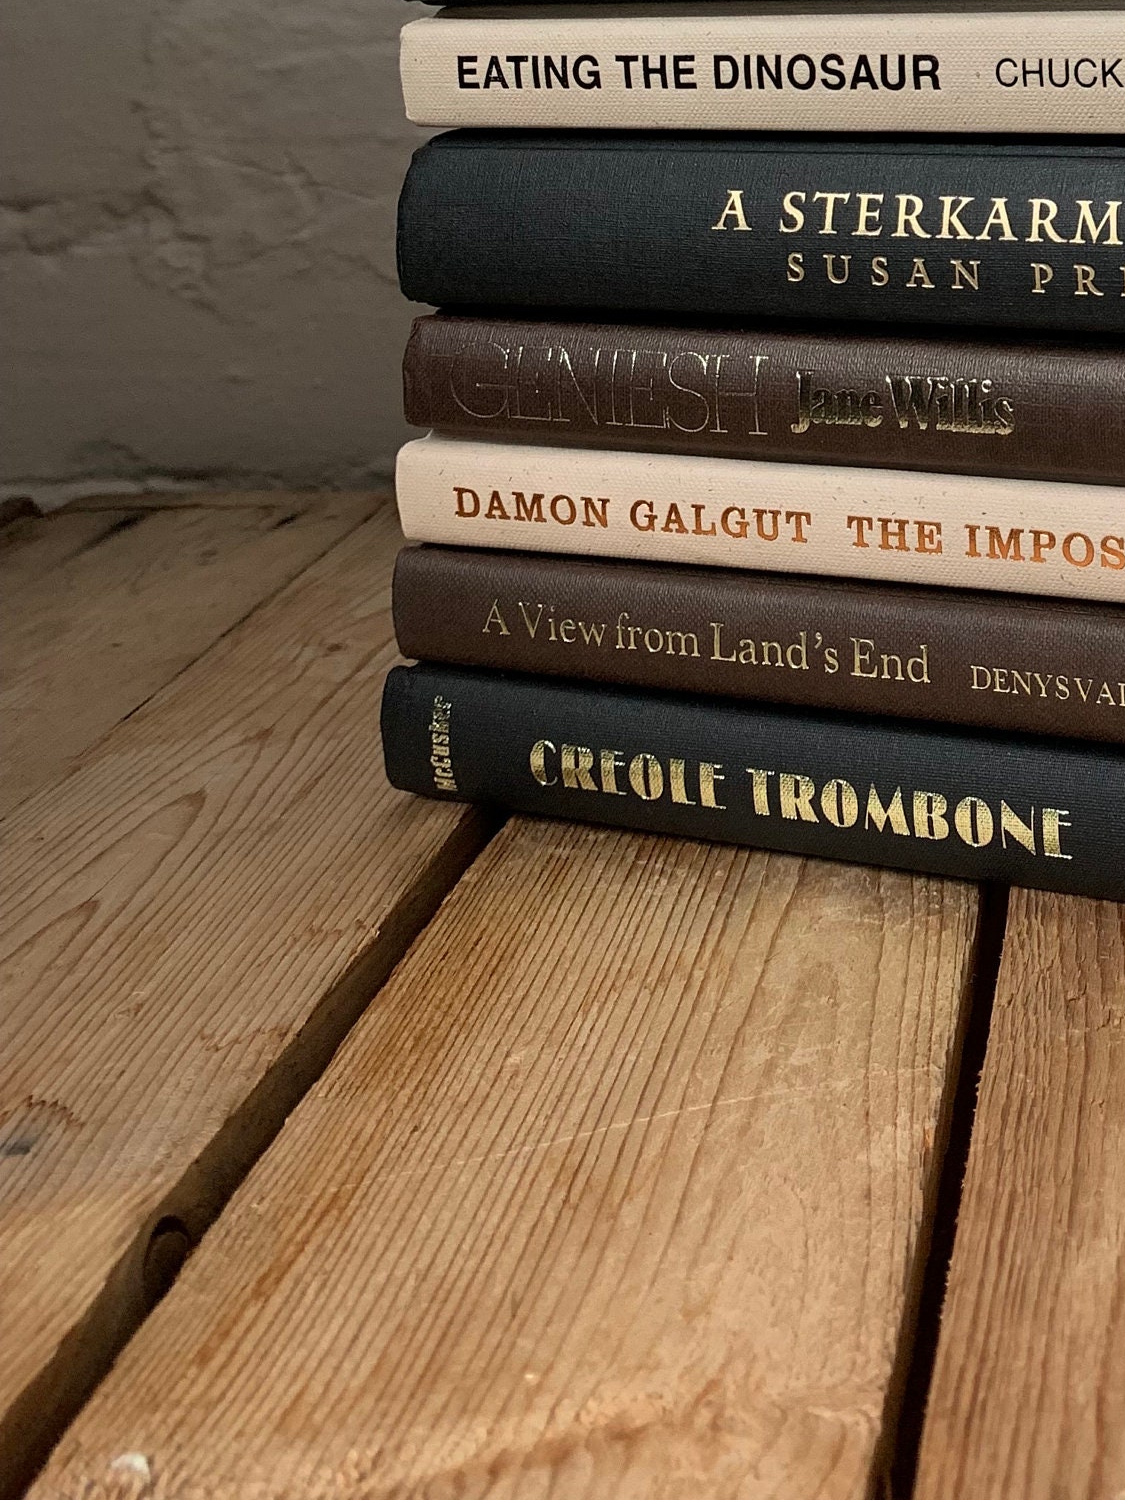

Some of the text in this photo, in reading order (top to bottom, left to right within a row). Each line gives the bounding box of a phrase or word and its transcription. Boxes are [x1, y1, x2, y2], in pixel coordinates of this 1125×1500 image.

[457, 54, 942, 91] EATING THE DINOSAUR
[995, 58, 1124, 90] CHUCK
[712, 190, 752, 231] A
[779, 191, 1123, 246] STERKARM
[787, 254, 981, 290] SUSAN
[790, 370, 1016, 437] Jane Willis
[453, 486, 813, 543] DAMON GALGUT
[847, 515, 943, 555] THE
[482, 598, 931, 684] A View from Land's End
[528, 739, 1073, 860] CREOLE TROMBONE
